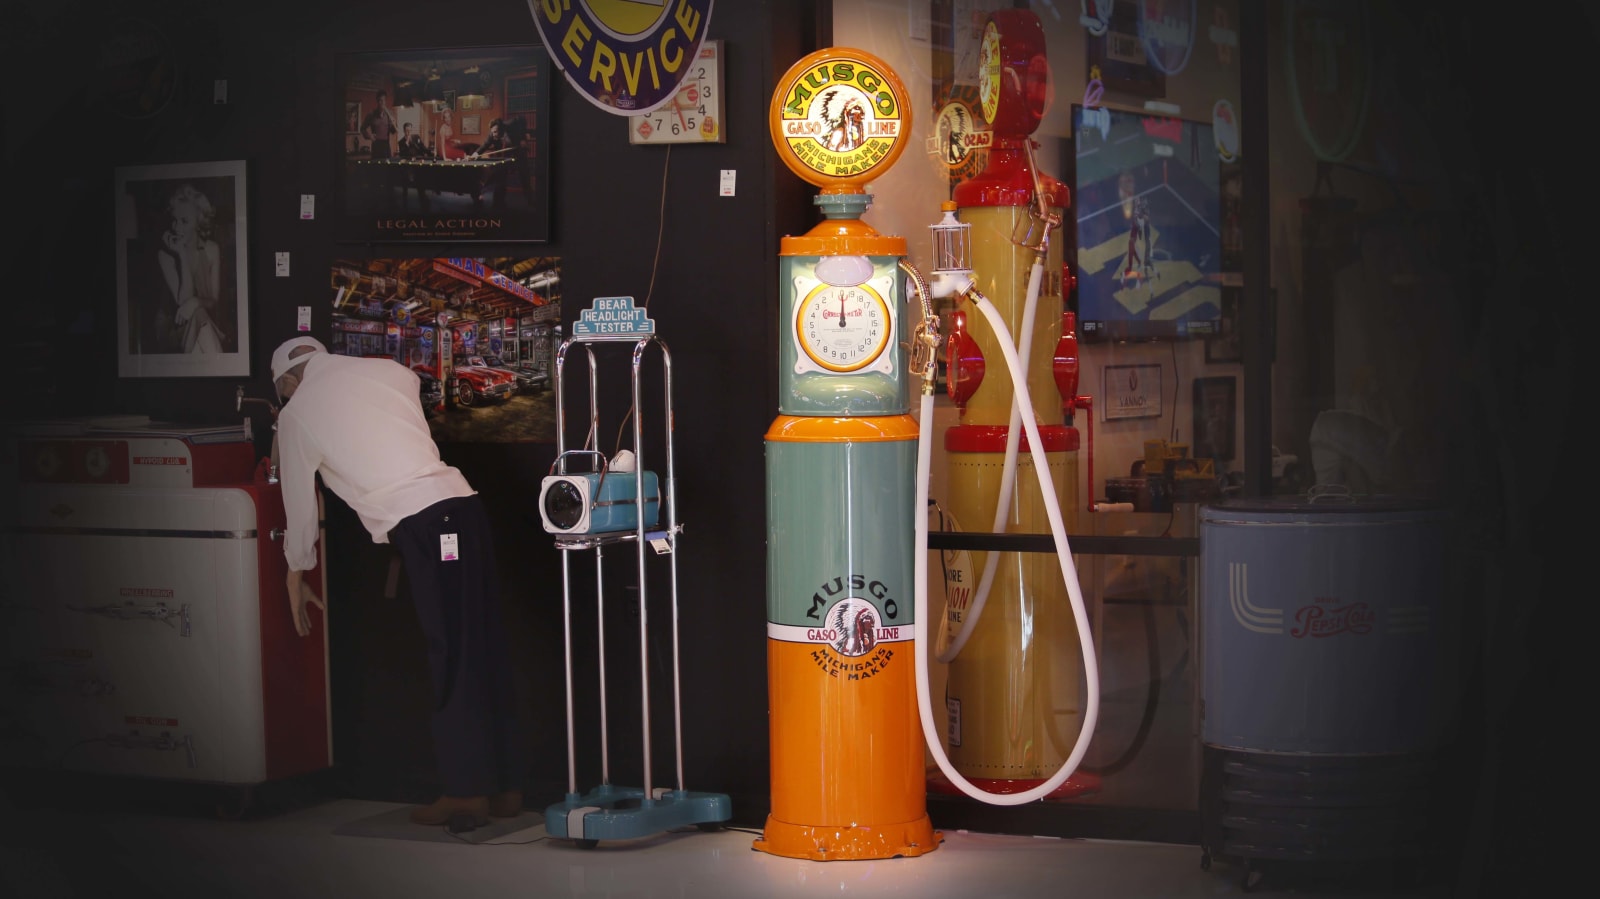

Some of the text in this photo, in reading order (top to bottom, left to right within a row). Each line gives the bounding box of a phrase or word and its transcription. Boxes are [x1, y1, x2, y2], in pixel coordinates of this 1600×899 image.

[543, 0, 700, 97] SERVICE
[698, 68, 706, 79] 2
[703, 86, 711, 98] 3
[786, 63, 895, 116] MUSGO
[698, 104, 706, 116] 4
[655, 119, 663, 131] 7
[672, 123, 680, 135] 6
[687, 118, 695, 130] 5
[787, 121, 897, 135] GASO LINE
[793, 142, 827, 172] MILE
[835, 142, 891, 175] MAKER
[377, 219, 501, 229] LEGAL ACTION
[492, 271, 534, 301] SERVICE
[599, 299, 627, 310] BEAR
[585, 310, 641, 322] HEADLIGHT
[594, 321, 634, 333] TESTER
[840, 352, 847, 360] 10
[806, 574, 898, 621] MUSGO
[807, 627, 899, 641] GASO LINE
[810, 650, 894, 681] MILE MAKER
